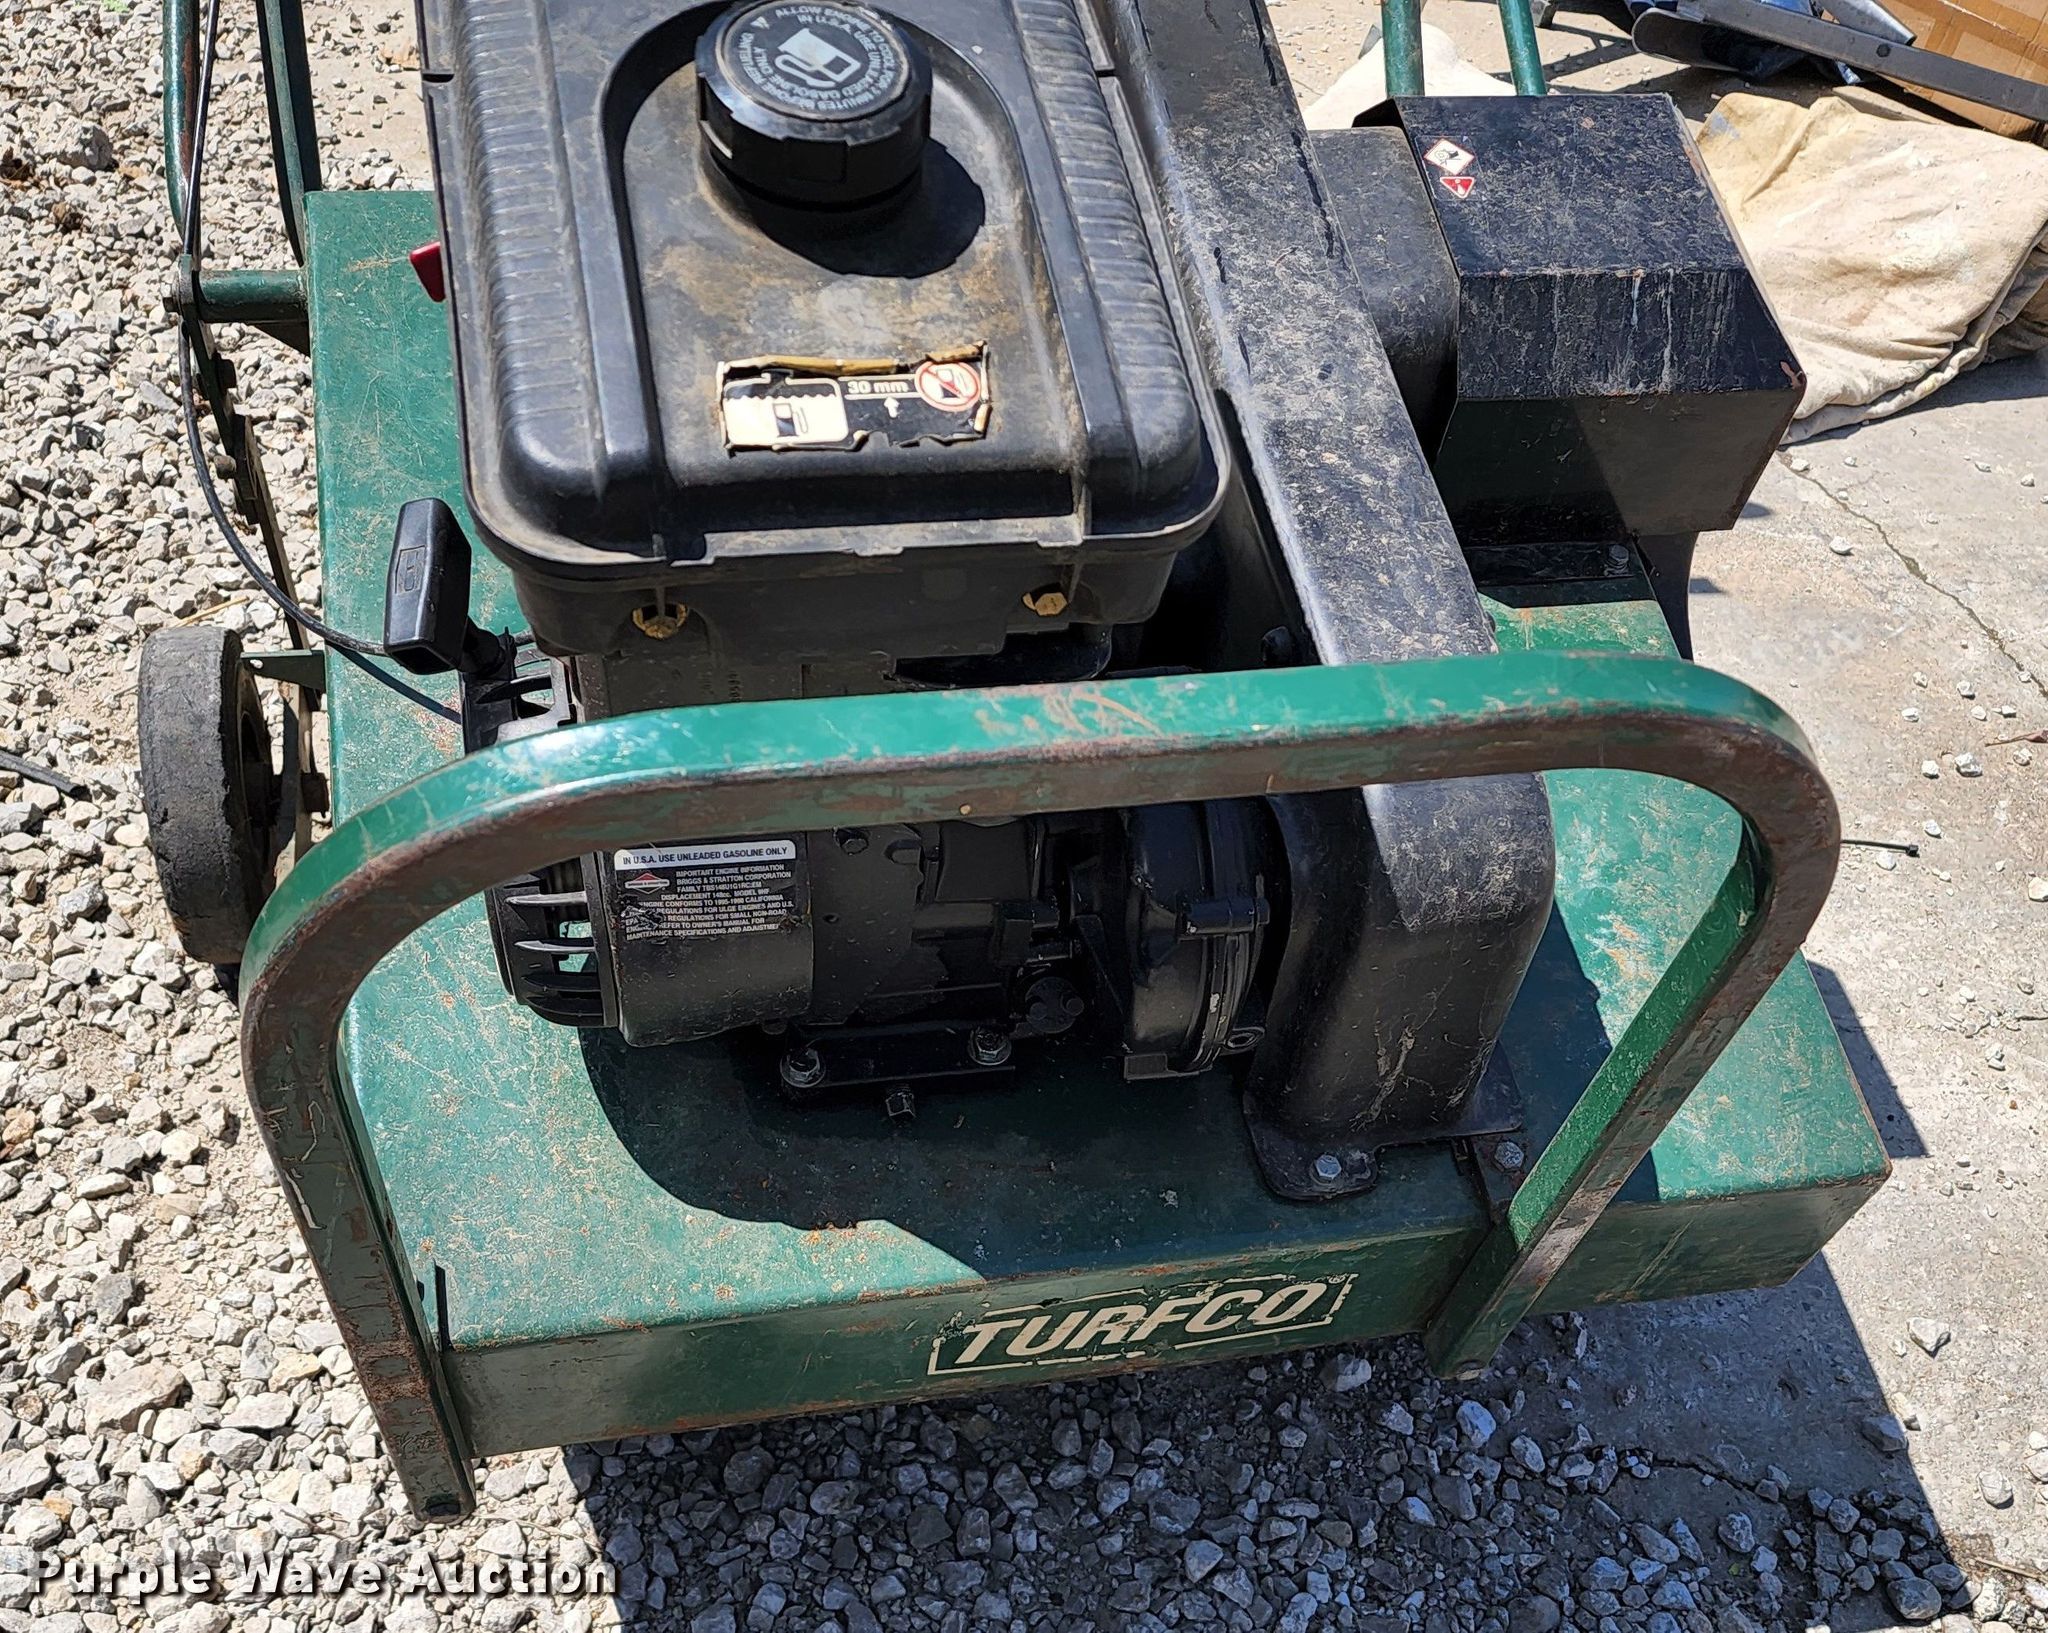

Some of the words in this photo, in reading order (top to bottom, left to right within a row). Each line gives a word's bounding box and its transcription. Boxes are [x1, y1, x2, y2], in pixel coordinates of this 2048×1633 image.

[775, 6, 822, 19] ALLOW
[824, 8, 872, 33] ENGINE
[868, 29, 886, 44] TO
[797, 15, 813, 24] IN
[853, 31, 877, 53] USE
[753, 46, 774, 75] ONLY
[847, 380, 872, 394] 30
[874, 381, 910, 393] mm
[623, 856, 632, 865] IN
[633, 855, 657, 865] U.S.A.
[659, 854, 675, 862] USE
[677, 851, 721, 861] UNLEADED
[723, 849, 764, 858] GASOLINE
[765, 847, 788, 856] ONLY
[676, 869, 714, 877] IMPORTANT
[715, 867, 739, 875] ENGINE
[740, 864, 785, 874] INFORMATION
[676, 877, 703, 885] BRIGGS
[709, 875, 744, 883] STRATTON
[744, 872, 792, 881] CORPORATION
[676, 885, 701, 893] FAMILY
[661, 892, 712, 900] DISPLACEMENT
[665, 899, 703, 907] CONFORMS
[745, 894, 784, 903] CALIFORNIA
[703, 905, 718, 913] FOR
[738, 903, 766, 911] ENGINES
[730, 911, 752, 919] SMALL
[691, 920, 722, 928] OWNER'S
[626, 930, 673, 940] MAINTENANCE
[673, 927, 727, 936] SPECIFICATIONS
[727, 926, 742, 934] AND
[954, 1283, 1328, 1365] TURFCO
